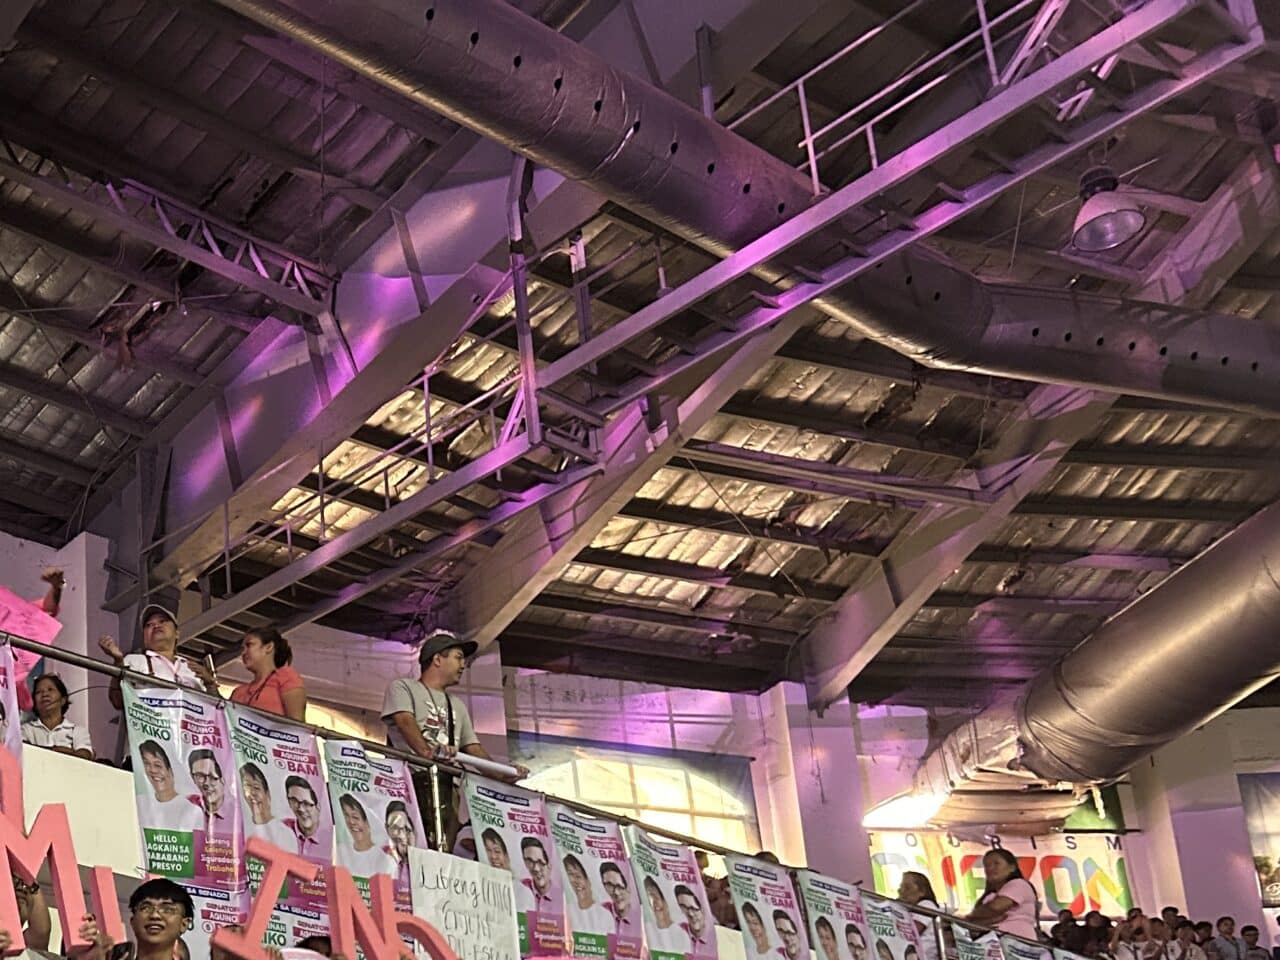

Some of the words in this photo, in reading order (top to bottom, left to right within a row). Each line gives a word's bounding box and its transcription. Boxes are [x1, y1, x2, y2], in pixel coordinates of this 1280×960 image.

[141, 723, 171, 741] KIKO
[242, 747, 268, 764] KIKO
[288, 761, 319, 776] BAM
[340, 779, 370, 792] KIKO
[481, 813, 505, 828] KIKO
[521, 823, 548, 838] BAM
[153, 835, 177, 843] HELLO
[148, 843, 179, 853] AGKAIN
[600, 849, 627, 863] BAM
[152, 861, 182, 871] PRESYO
[673, 872, 698, 885] BAM
[771, 897, 794, 909] BAM
[210, 912, 237, 922] AQUINO
